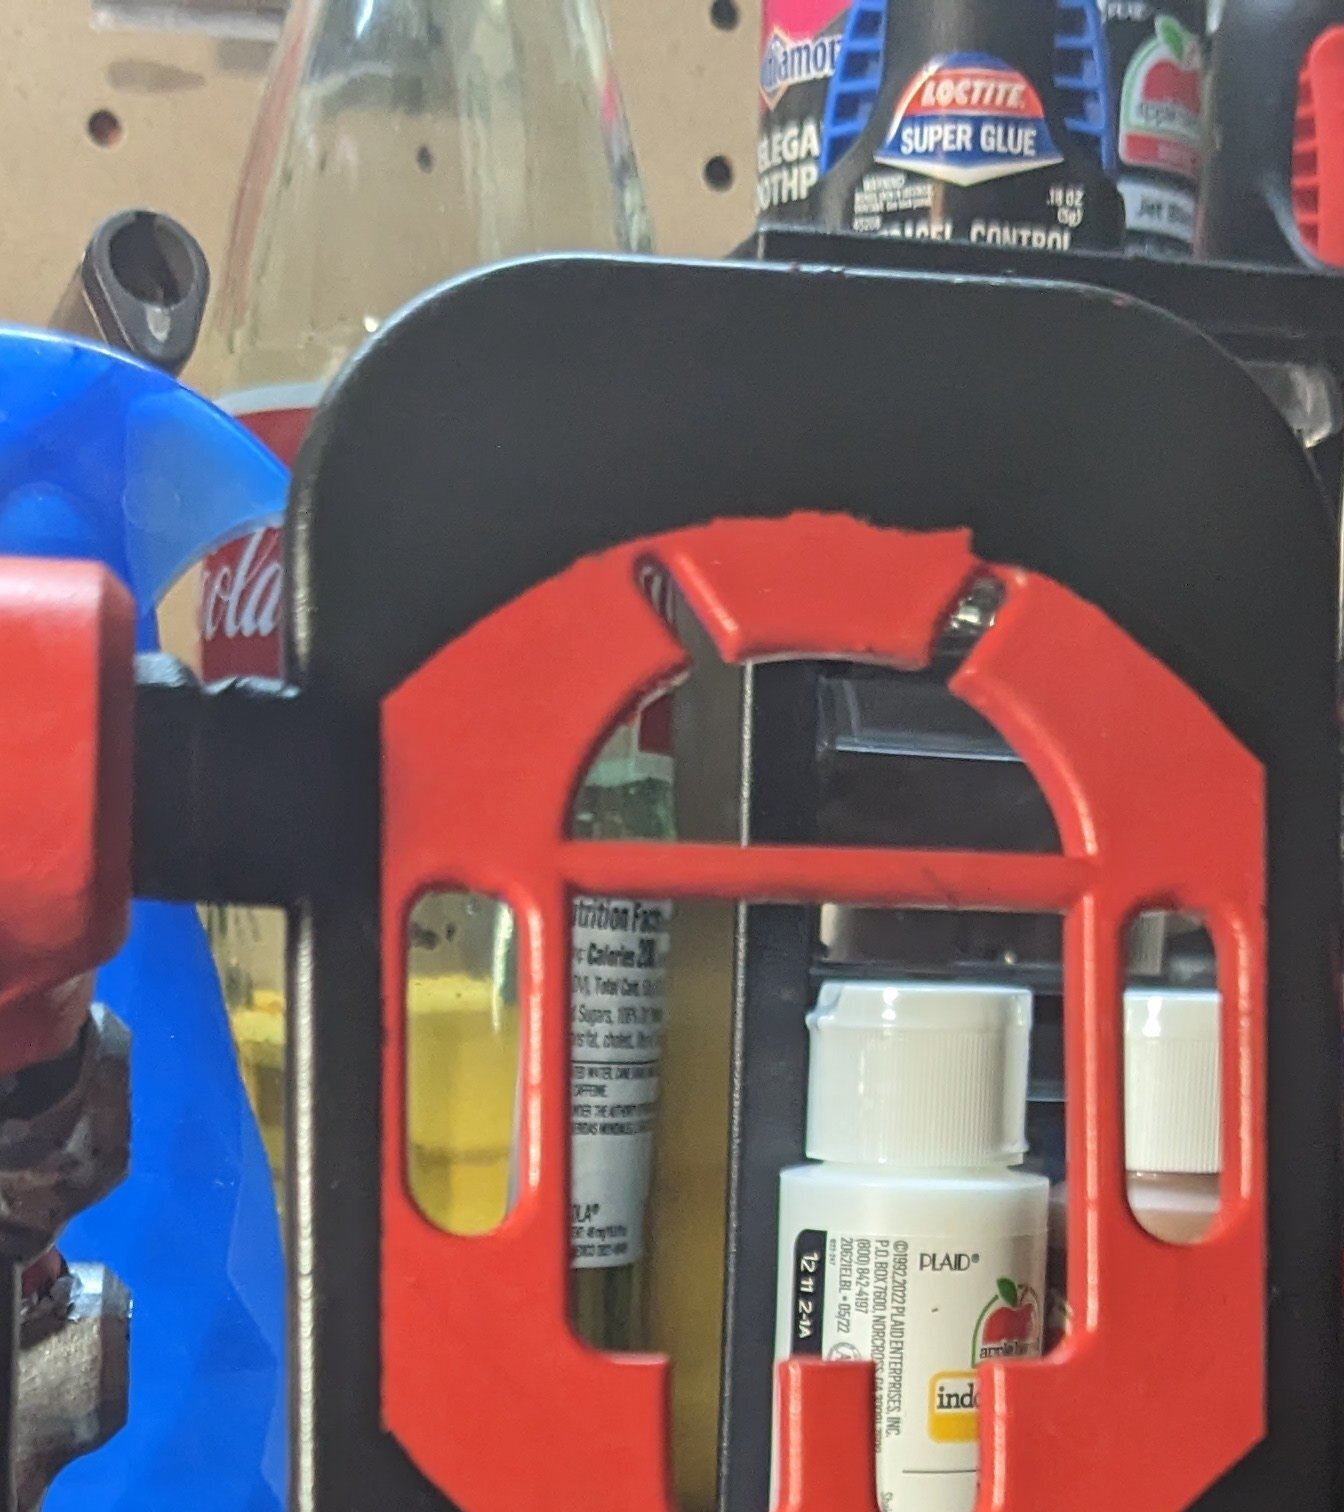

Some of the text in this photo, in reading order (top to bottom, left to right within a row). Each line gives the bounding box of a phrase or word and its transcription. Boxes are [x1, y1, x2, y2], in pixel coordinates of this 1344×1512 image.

[900, 121, 1037, 157] SUPER GLUE
[202, 526, 283, 641] ola
[838, 1237, 853, 1294] 20621ELBL
[874, 1239, 890, 1261] P.O.
[854, 1238, 871, 1314] (800) 842-4197
[873, 1261, 889, 1284] BOX
[798, 1252, 819, 1338] 12 11 2-1A
[872, 1284, 888, 1314] 7600,
[835, 1302, 852, 1334] 05/22
[889, 1305, 906, 1339] PLAID
[886, 1340, 905, 1415] ENTERPRISES,
[886, 1416, 902, 1438] INC.
